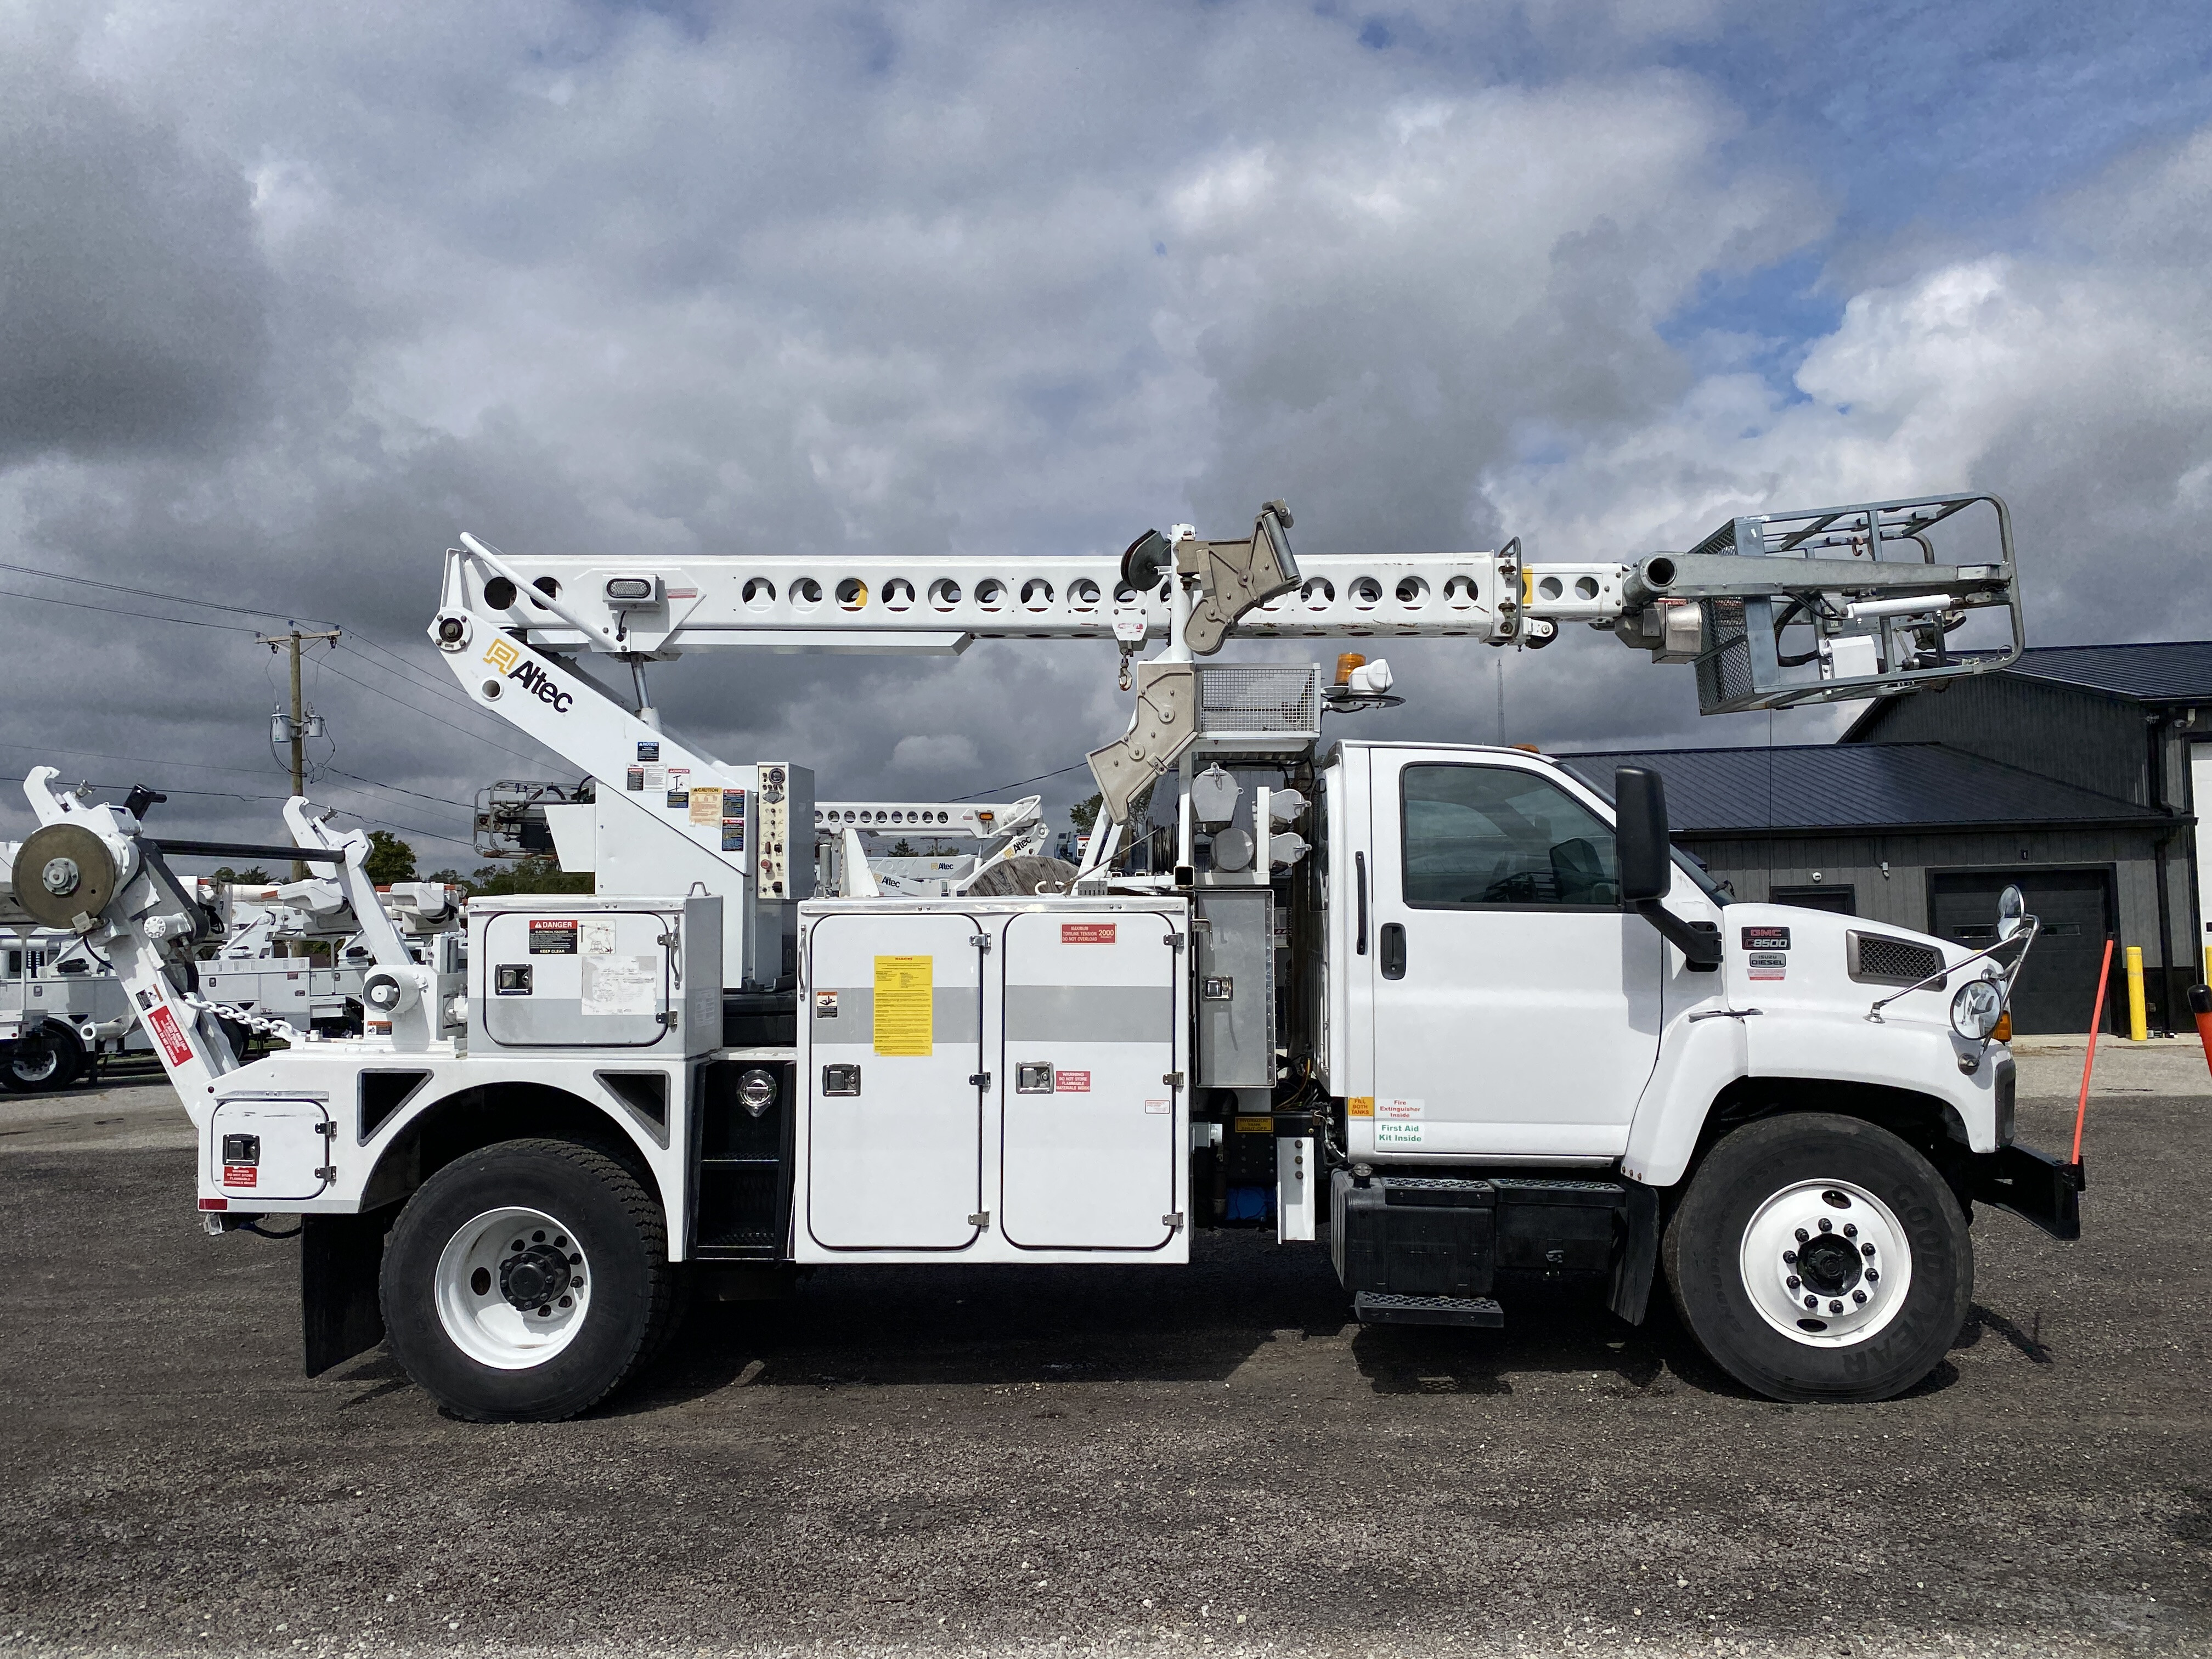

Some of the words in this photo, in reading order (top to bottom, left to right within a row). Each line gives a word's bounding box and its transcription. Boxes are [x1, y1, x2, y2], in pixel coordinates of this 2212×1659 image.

[507, 660, 573, 713] Altec
[1013, 836, 1031, 854] Altec
[881, 876, 900, 888] Altec
[1745, 939, 1788, 947] C8500
[1842, 1184, 1945, 1378] GOODYEAR
